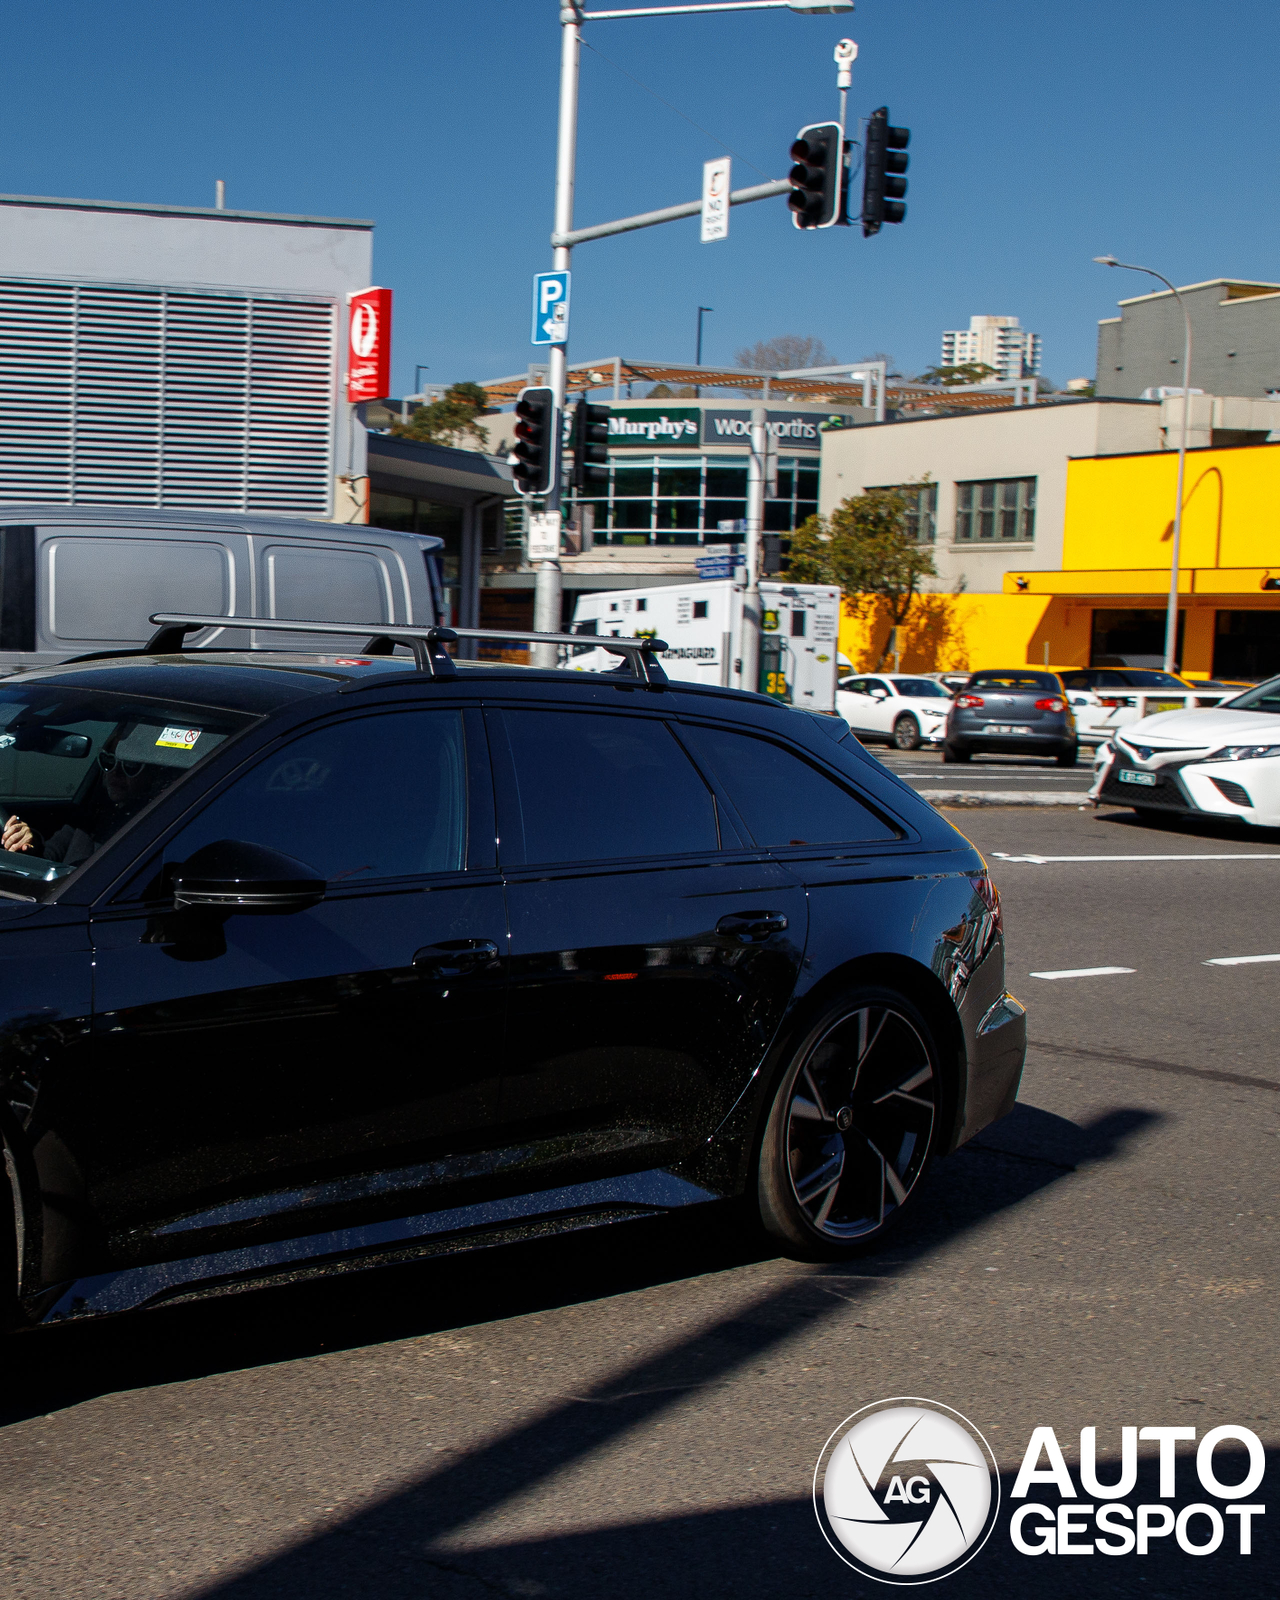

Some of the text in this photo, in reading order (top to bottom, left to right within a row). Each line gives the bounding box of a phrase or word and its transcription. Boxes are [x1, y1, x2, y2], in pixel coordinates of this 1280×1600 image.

[540, 279, 563, 314] P
[607, 416, 698, 440] Murphy's
[714, 418, 817, 438] Wooworths
[662, 647, 716, 660] ARMAGUARD
[766, 672, 787, 694] 35
